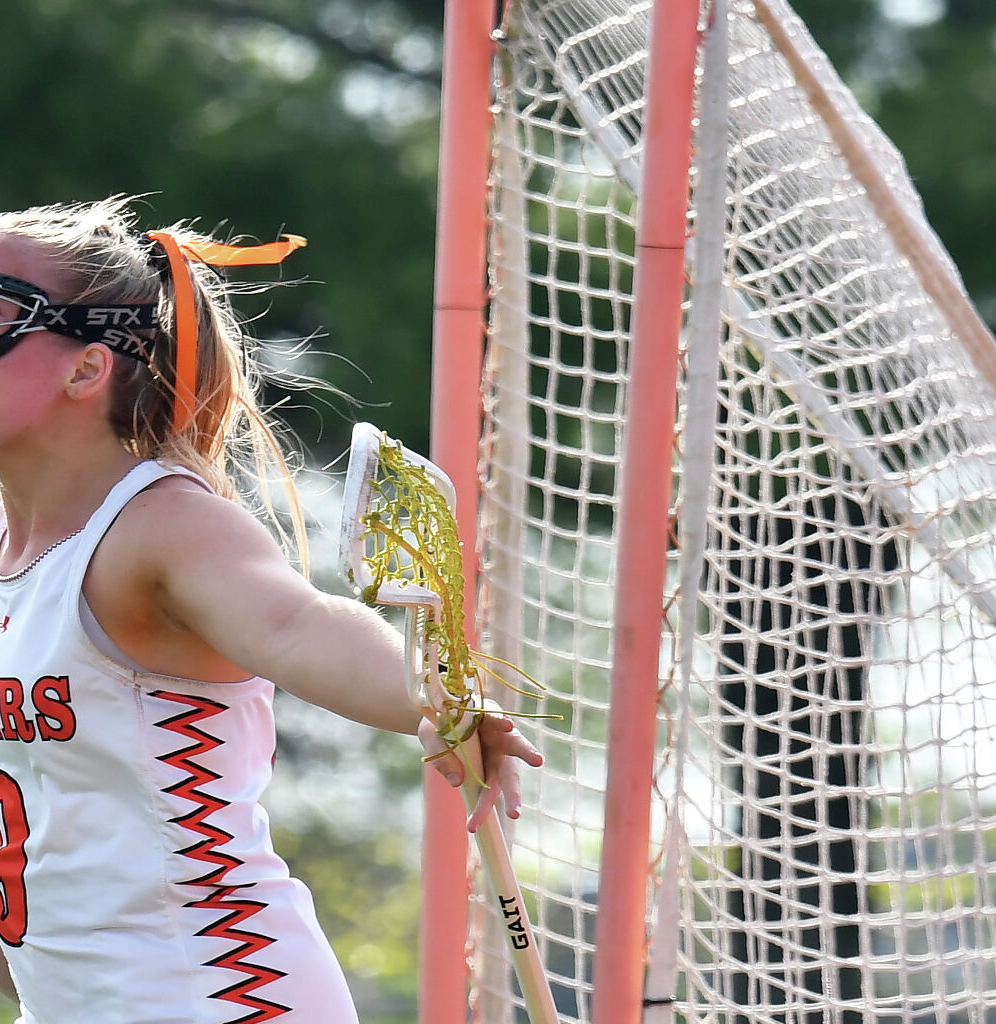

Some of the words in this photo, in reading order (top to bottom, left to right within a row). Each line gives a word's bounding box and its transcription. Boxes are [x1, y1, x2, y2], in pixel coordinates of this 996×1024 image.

[85, 306, 142, 326] STX
[100, 328, 149, 357] STX
[498, 895, 530, 950] GAIT
